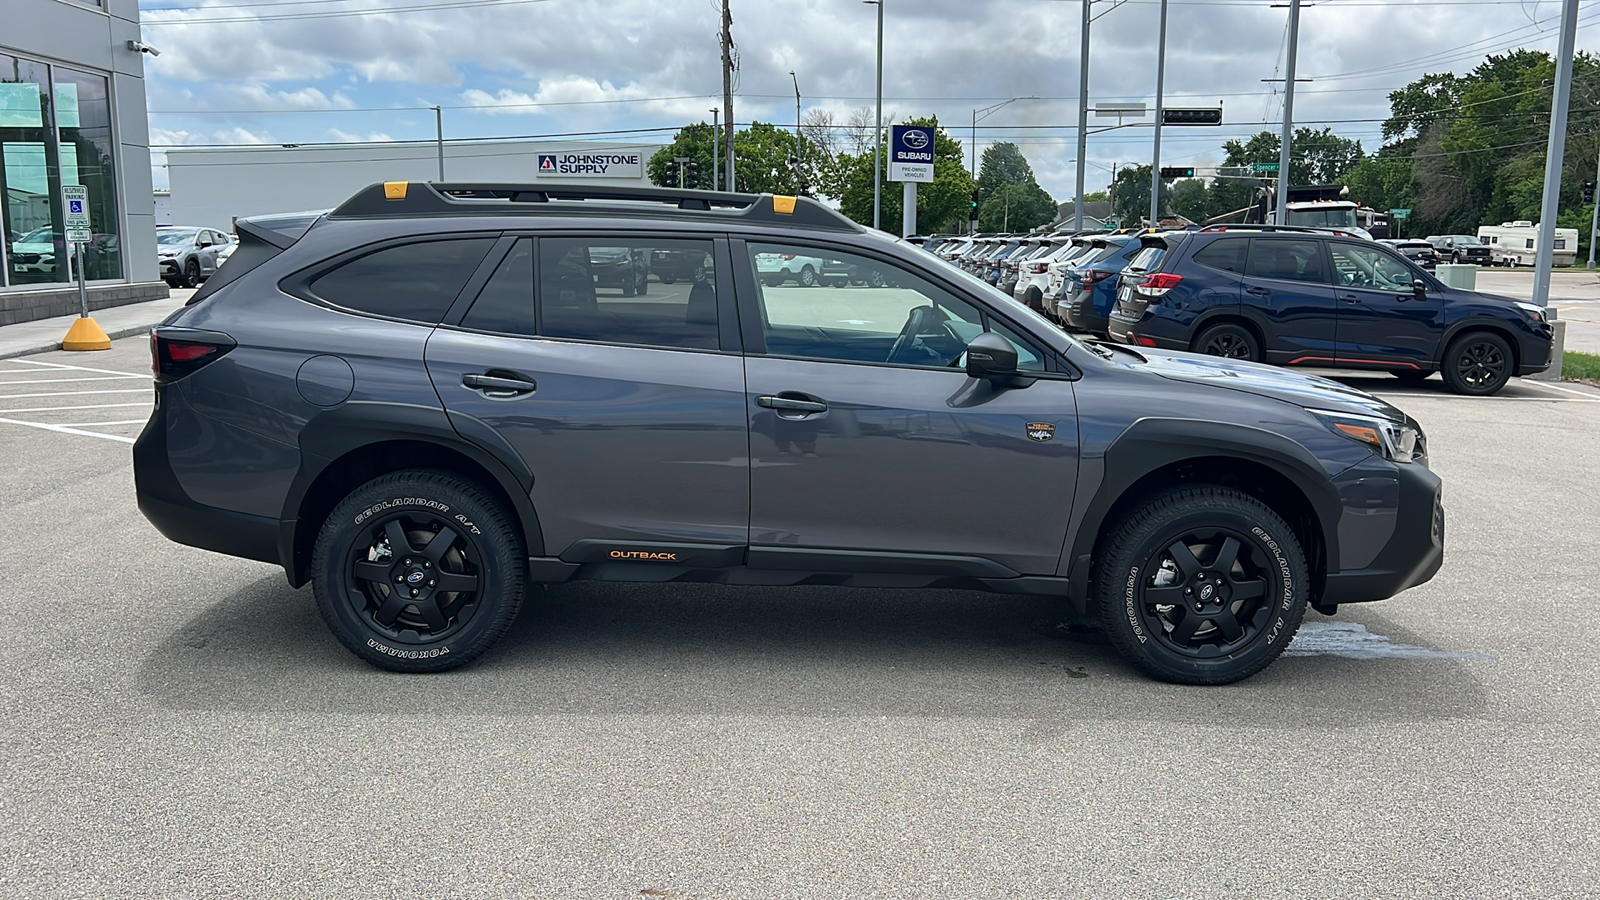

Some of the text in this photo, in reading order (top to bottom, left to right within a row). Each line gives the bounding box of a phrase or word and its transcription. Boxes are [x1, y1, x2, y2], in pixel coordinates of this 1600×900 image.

[559, 154, 638, 165] JOHNSTONE
[897, 152, 931, 160] SUBARU
[559, 164, 609, 174] SUPPLY
[354, 497, 481, 536] GEOLANDAR A/T
[610, 550, 677, 560] OUTBACK
[1251, 526, 1293, 645] GEOLANDAR A/T
[1123, 566, 1148, 644] YOKOHAMA
[366, 638, 450, 660] YOKOHAMA
